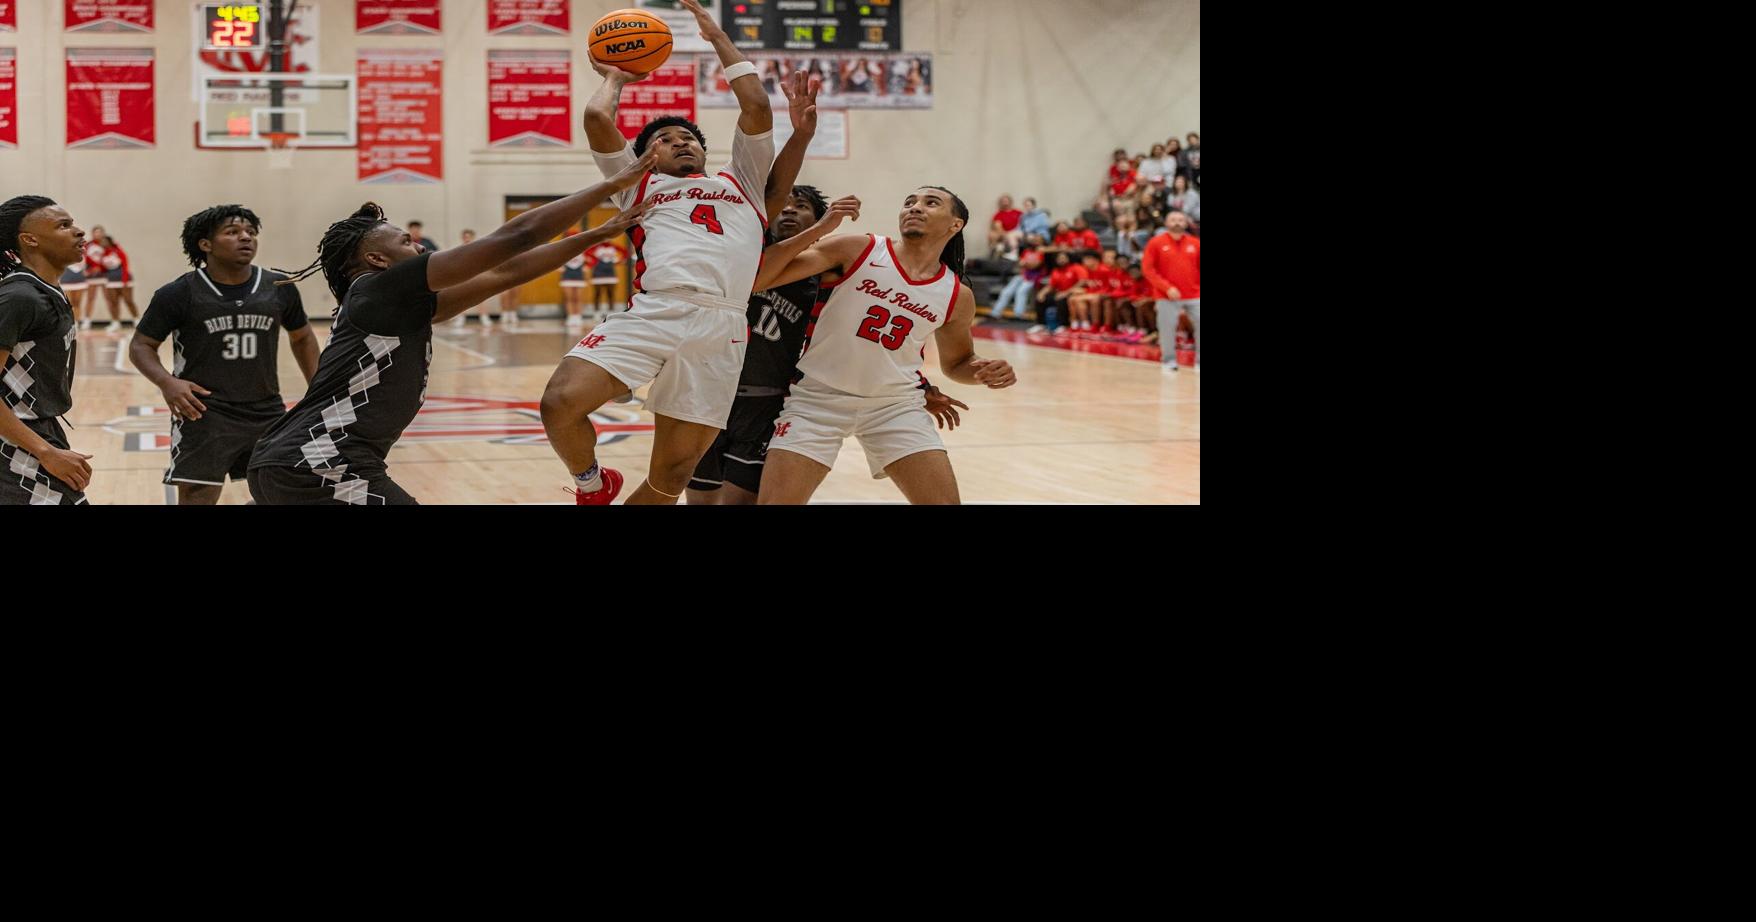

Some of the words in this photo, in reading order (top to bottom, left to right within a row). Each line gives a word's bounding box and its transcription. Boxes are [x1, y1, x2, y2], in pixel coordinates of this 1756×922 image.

[212, 20, 253, 47] 22
[594, 20, 648, 36] Wilson
[606, 39, 646, 55] NCAA
[651, 190, 682, 204] Red
[686, 188, 744, 204] Raiders
[690, 204, 724, 235] 4
[856, 279, 893, 301] Red
[889, 292, 937, 323] Raiders
[204, 316, 234, 334] BLUE
[237, 314, 274, 331] DEVILS
[752, 304, 781, 342] 10
[856, 304, 914, 351] 23
[222, 332, 257, 360] 30
